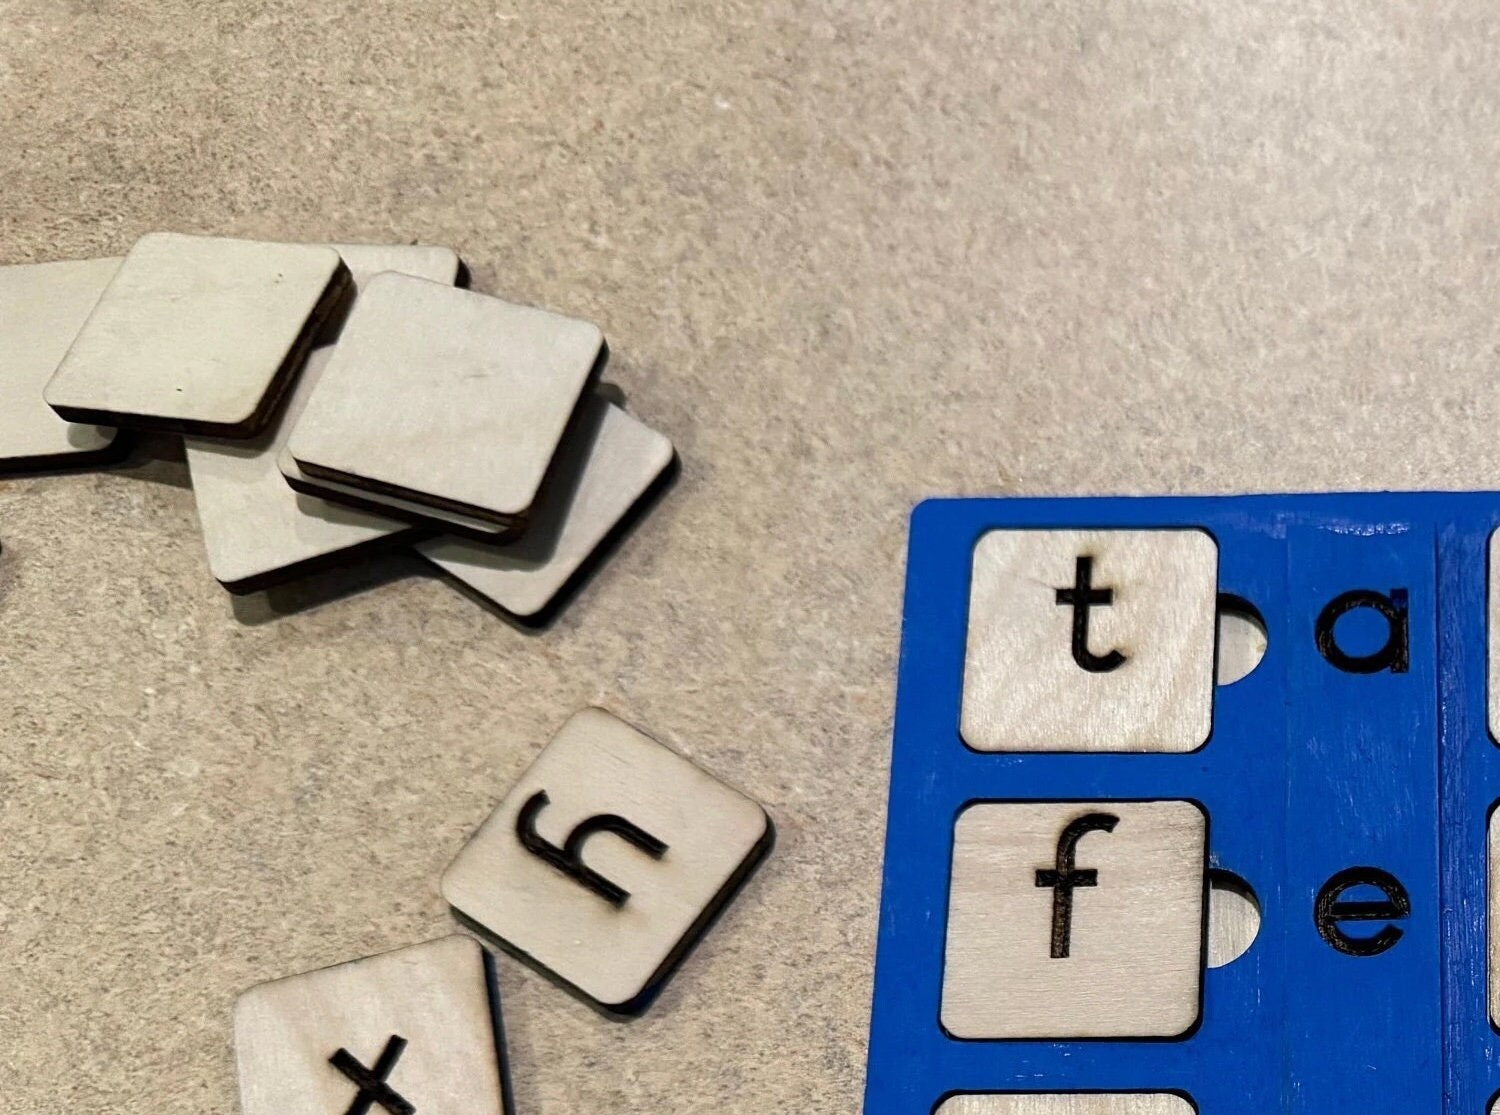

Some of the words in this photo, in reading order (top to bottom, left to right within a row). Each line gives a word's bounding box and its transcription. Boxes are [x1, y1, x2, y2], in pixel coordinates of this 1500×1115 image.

[1056, 556, 1127, 672] t
[1315, 589, 1409, 674] a
[1034, 811, 1121, 959] f
[1314, 867, 1410, 956] e
